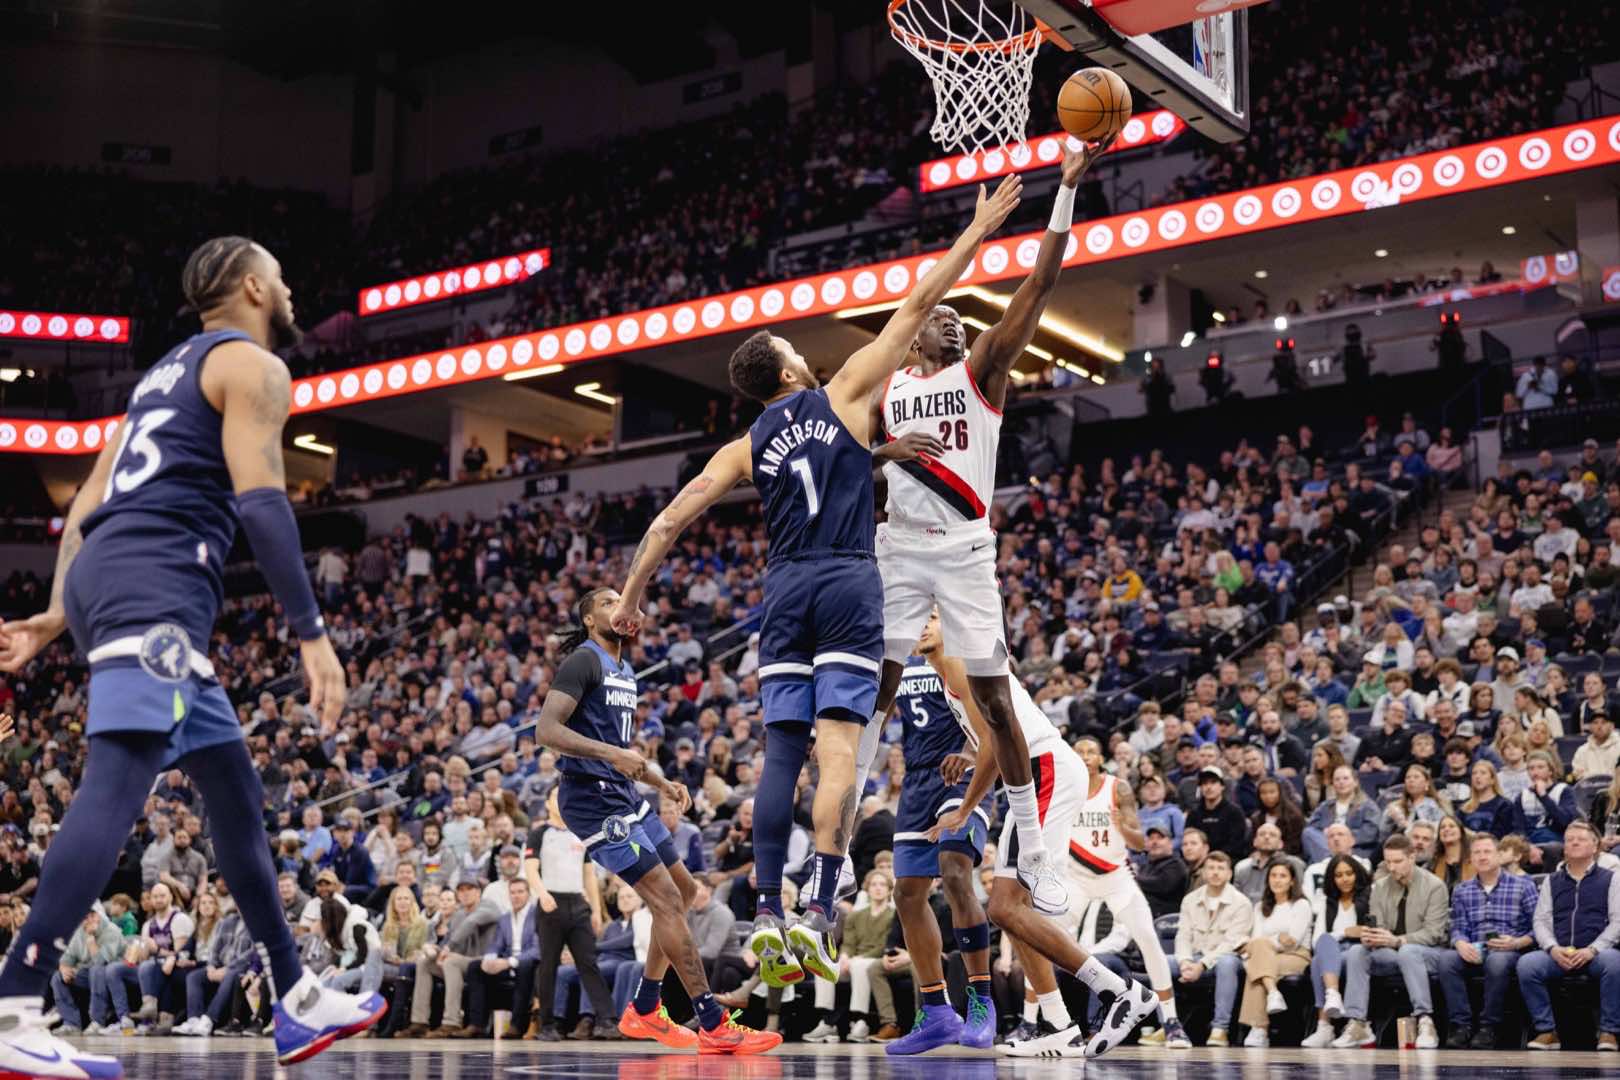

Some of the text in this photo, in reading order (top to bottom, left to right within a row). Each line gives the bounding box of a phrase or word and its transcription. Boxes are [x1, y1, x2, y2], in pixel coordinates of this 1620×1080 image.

[891, 389, 966, 424] BLAZERS
[759, 419, 839, 477] ANDERSON
[938, 419, 969, 451] 26
[790, 457, 818, 515] 1
[896, 677, 943, 697] NNESOTA
[621, 711, 633, 742] 11
[910, 697, 929, 728] 5
[1072, 811, 1110, 828] AZERS
[1091, 829, 1110, 848] 34
